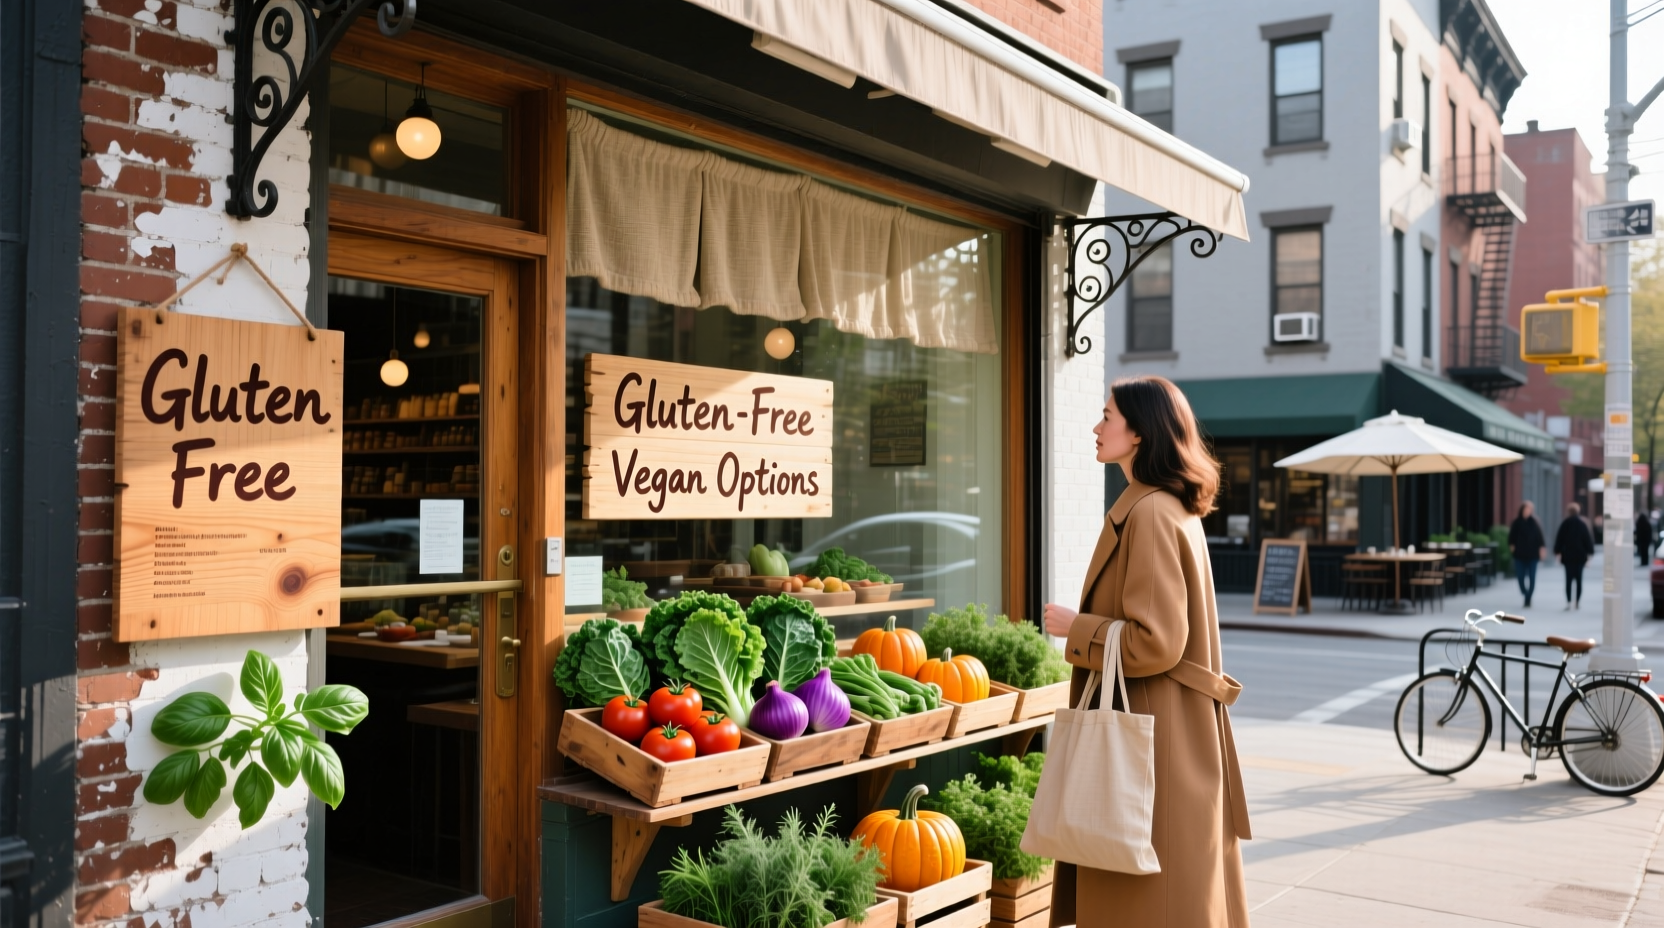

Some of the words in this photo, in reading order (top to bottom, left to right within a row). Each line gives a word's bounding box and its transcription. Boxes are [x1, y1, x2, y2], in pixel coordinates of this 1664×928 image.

[140, 347, 332, 432] Gluten
[613, 371, 815, 437] Gluten-Free
[171, 437, 297, 509] Free
[611, 447, 708, 514] Vegan
[716, 451, 820, 513] Options
